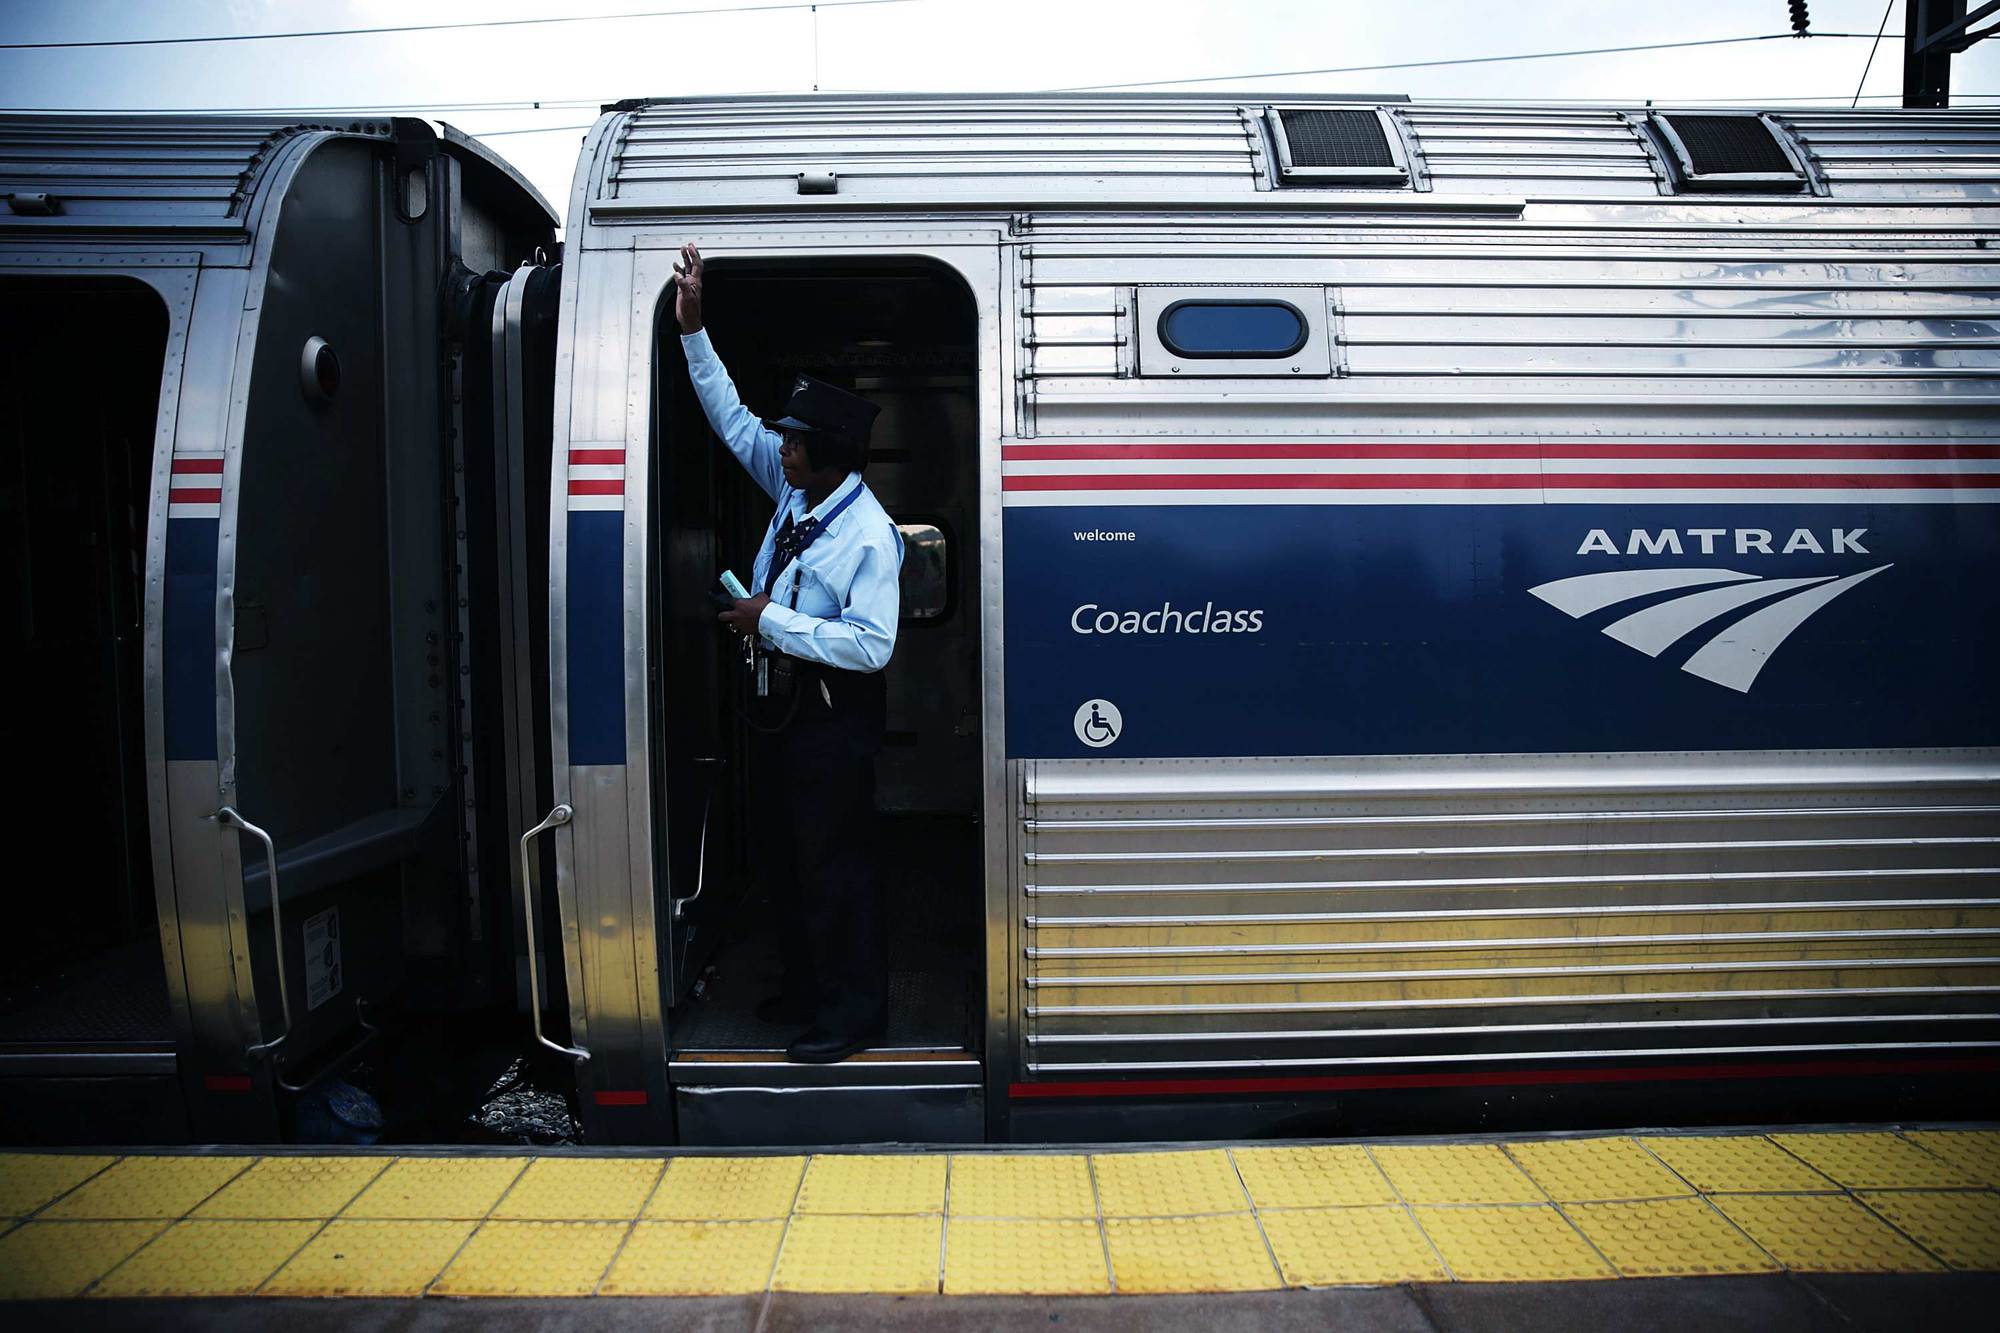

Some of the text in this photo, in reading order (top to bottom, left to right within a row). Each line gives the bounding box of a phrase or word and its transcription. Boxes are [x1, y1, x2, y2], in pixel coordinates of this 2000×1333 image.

[1073, 528, 1137, 542] welcome
[1576, 528, 1870, 555] AMTRAK
[1071, 601, 1265, 635] Coachclass
